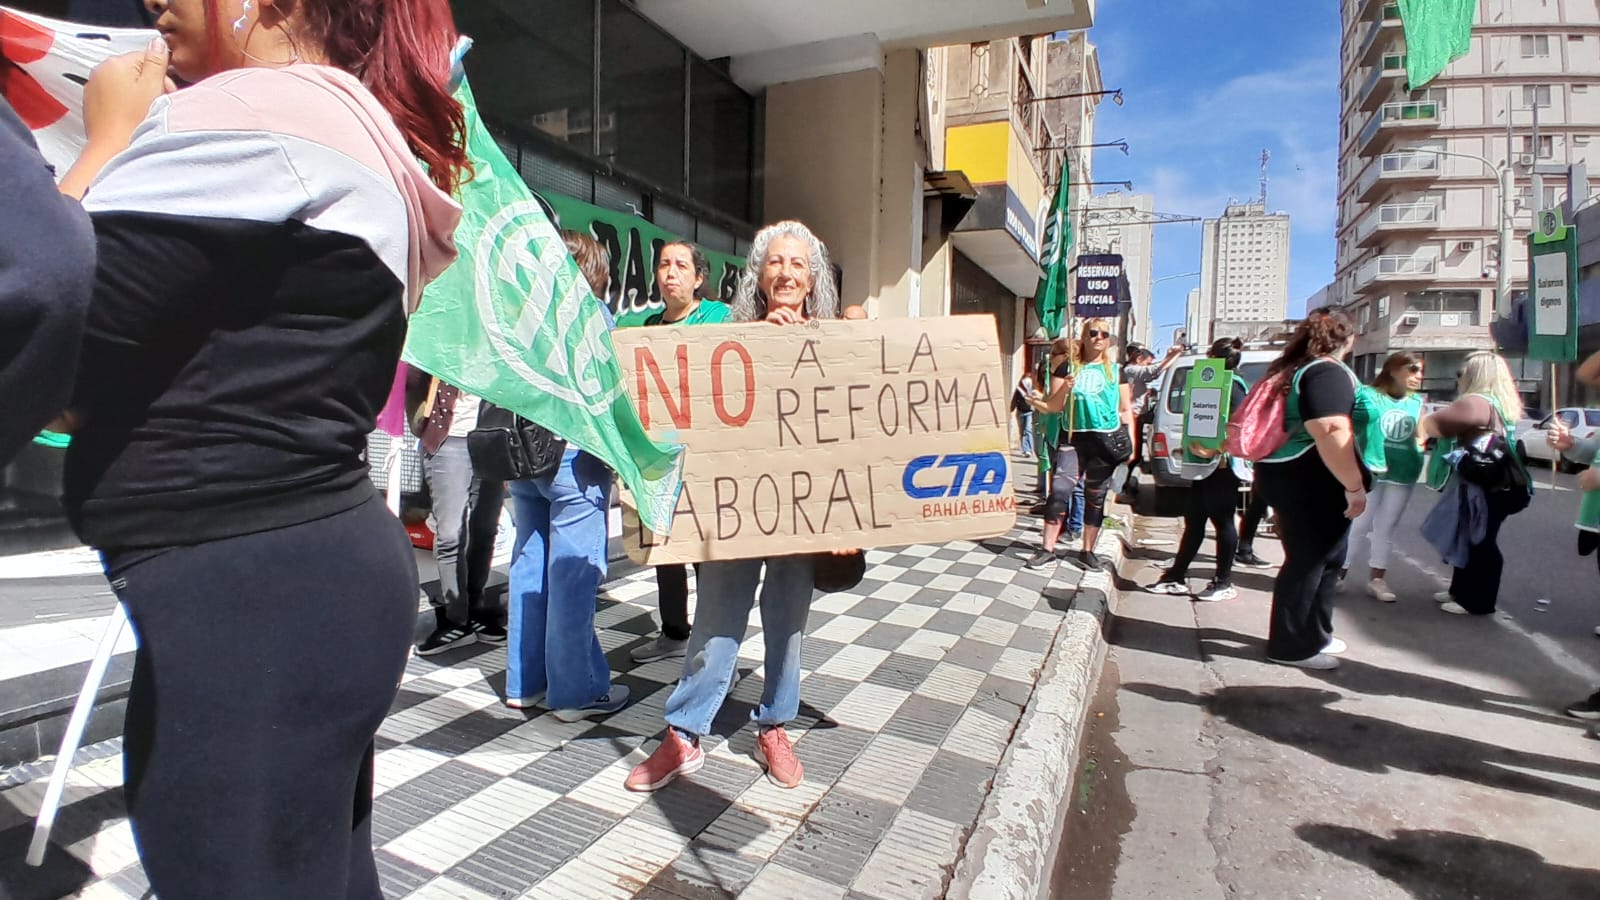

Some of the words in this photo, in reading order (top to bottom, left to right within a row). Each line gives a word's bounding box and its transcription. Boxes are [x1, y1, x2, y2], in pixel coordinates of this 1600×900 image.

[1078, 265, 1119, 278] RESERVADO
[1087, 280, 1109, 290] USO
[1078, 295, 1115, 305] OFICIAL
[634, 340, 756, 431] NO
[790, 339, 826, 379] A
[881, 332, 938, 375] LA
[776, 373, 1000, 447] REFORMA
[902, 452, 1006, 499] CTA
[972, 496, 1017, 514] BLANCA
